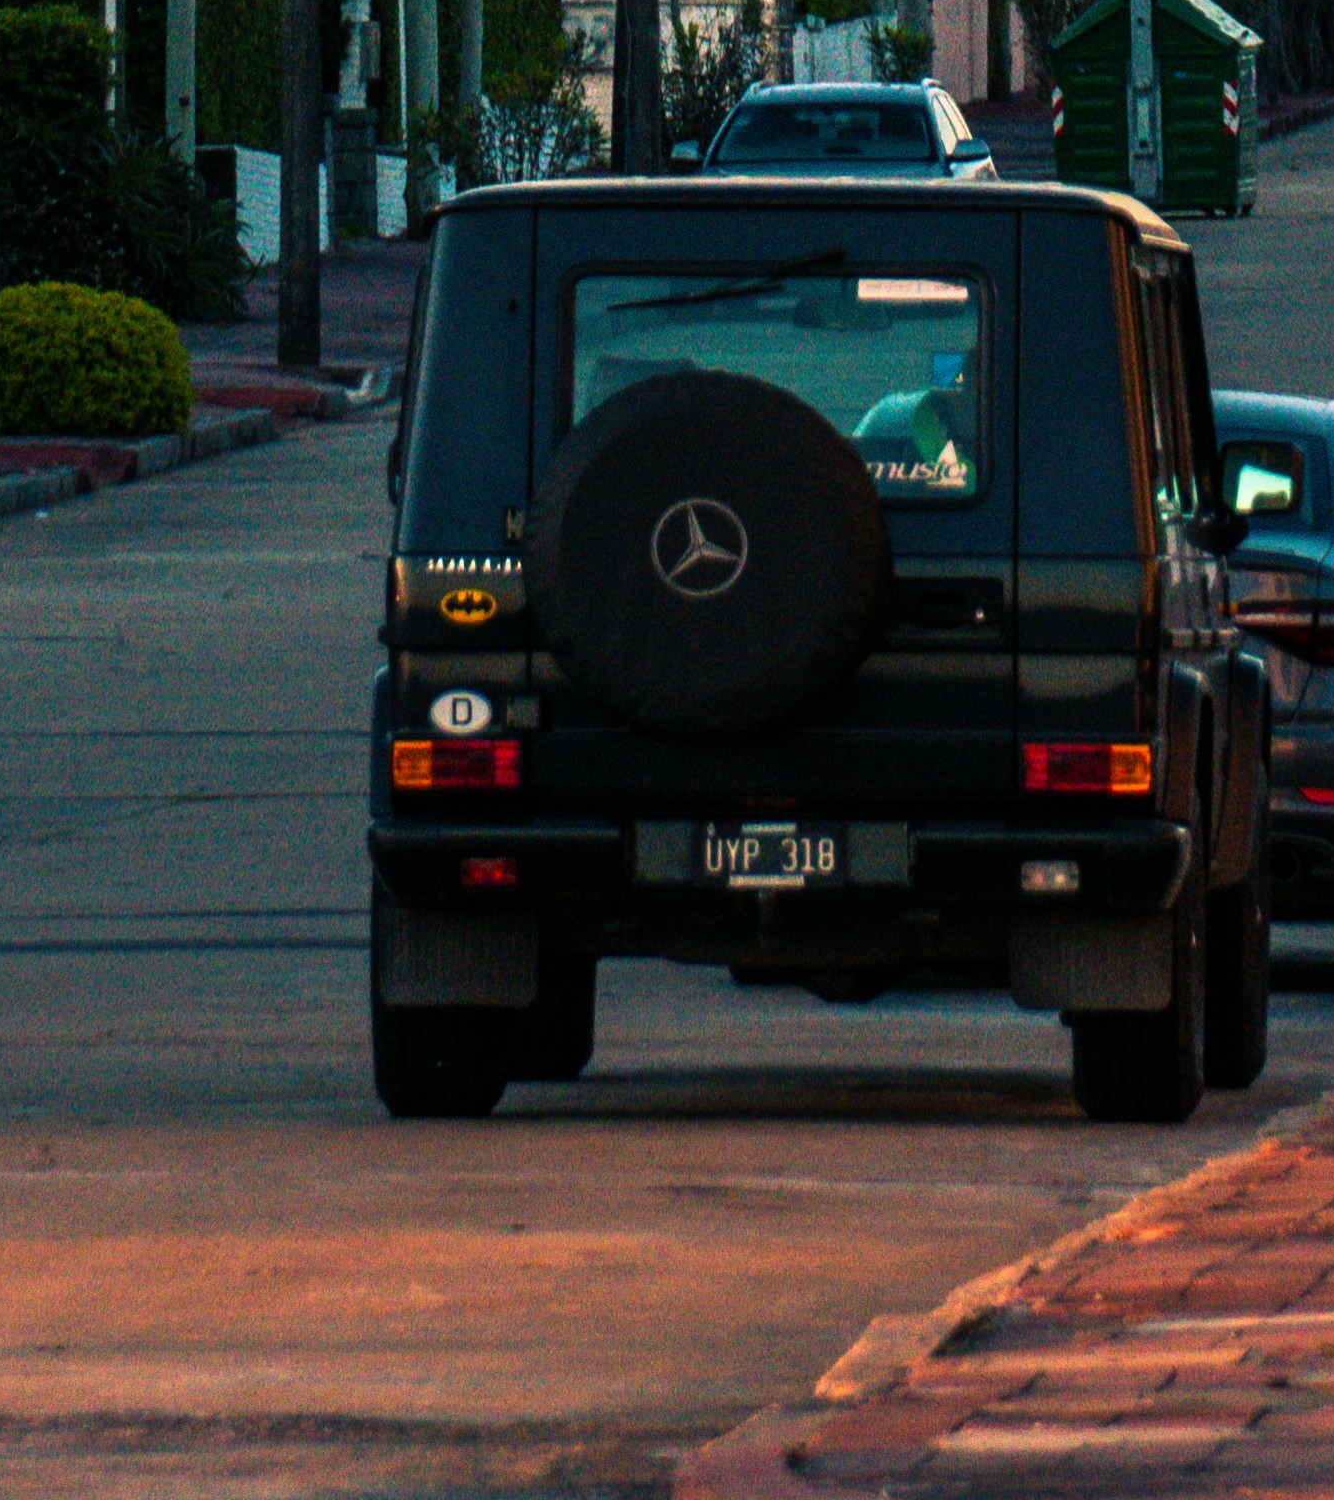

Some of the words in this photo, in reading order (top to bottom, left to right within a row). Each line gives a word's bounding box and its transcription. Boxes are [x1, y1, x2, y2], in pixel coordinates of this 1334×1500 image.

[450, 696, 473, 726] D
[705, 837, 761, 873] UYP
[781, 837, 835, 873] 318
